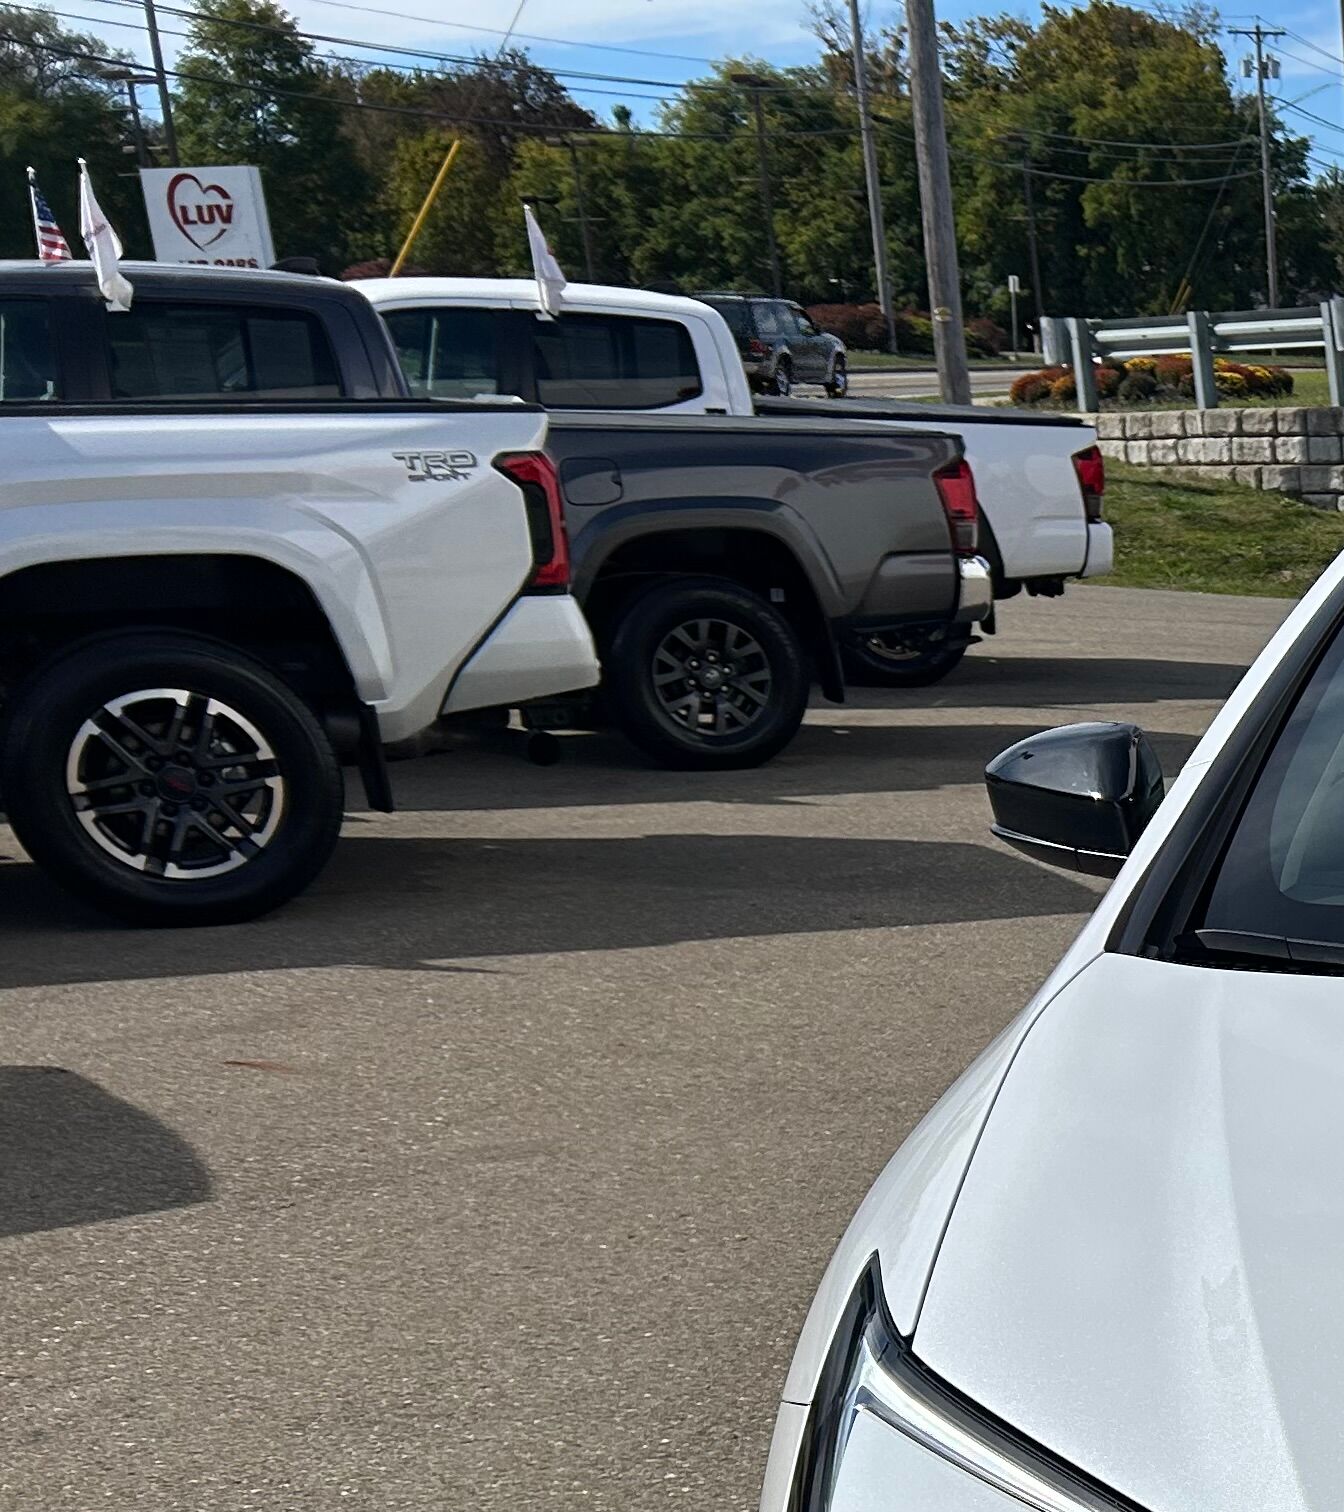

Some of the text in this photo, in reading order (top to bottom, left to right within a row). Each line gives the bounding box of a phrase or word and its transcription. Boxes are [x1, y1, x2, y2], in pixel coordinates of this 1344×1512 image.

[178, 203, 233, 225] LUV
[392, 450, 477, 475] TRD
[407, 472, 471, 482] SPORT
